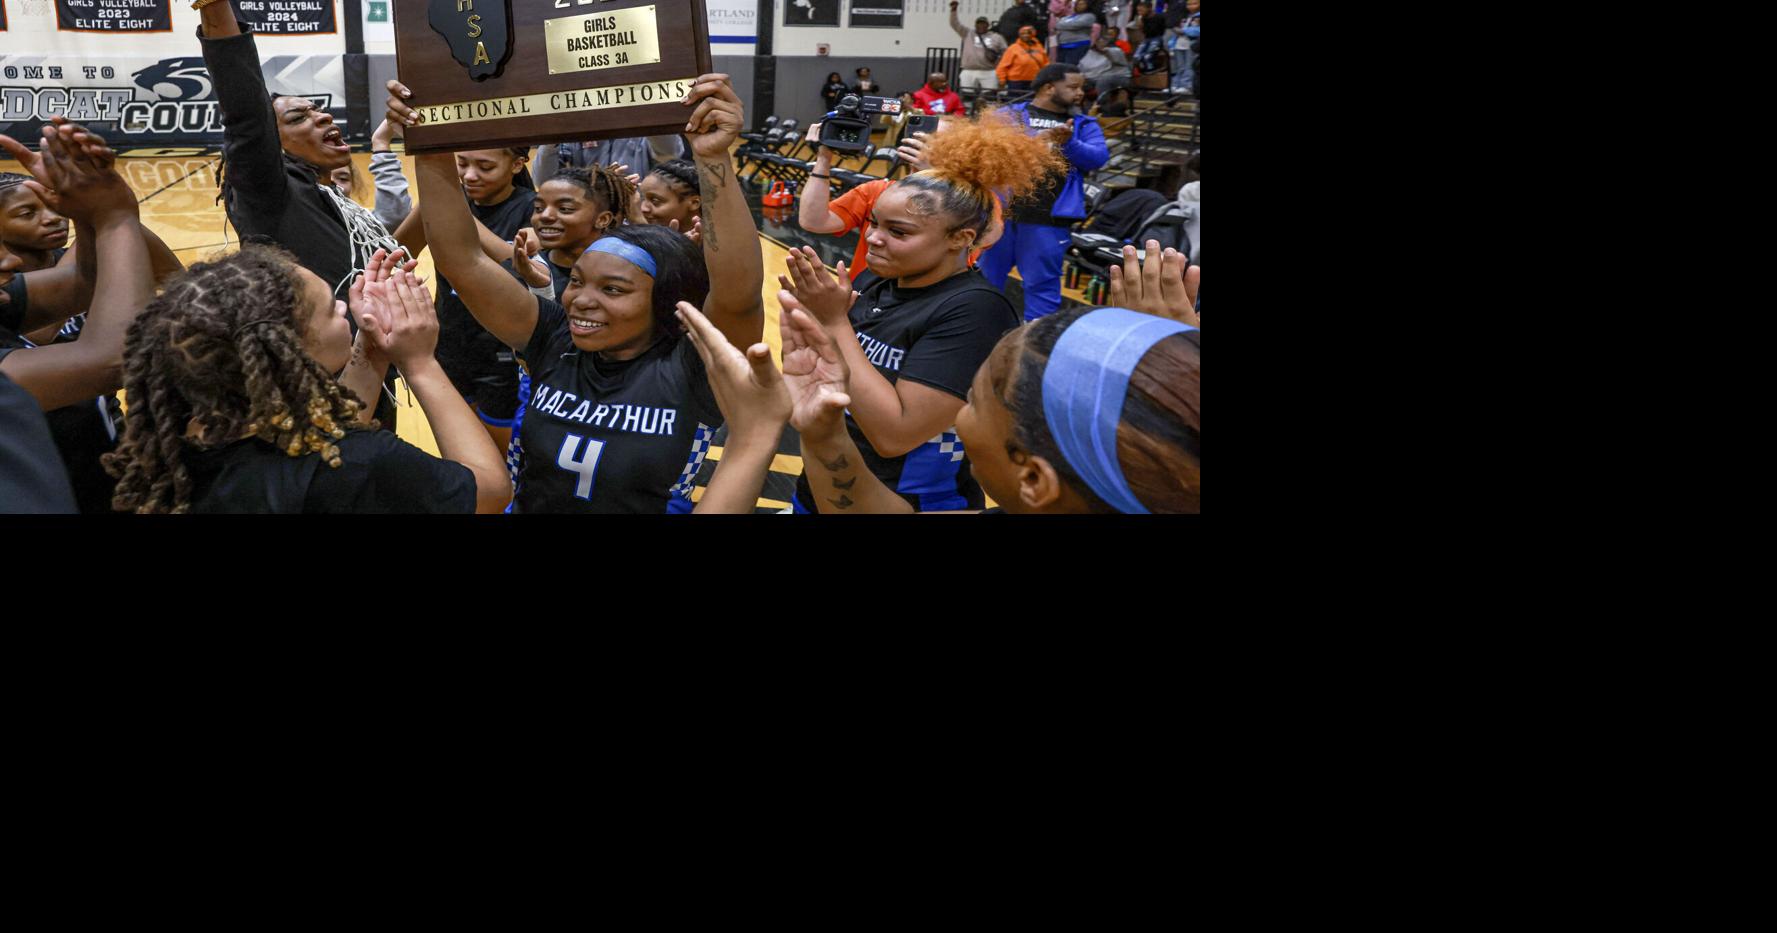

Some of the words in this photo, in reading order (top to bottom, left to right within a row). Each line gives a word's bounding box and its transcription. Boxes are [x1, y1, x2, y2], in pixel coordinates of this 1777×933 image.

[100, 0, 157, 8] VOLLEYBALL
[240, 1, 264, 11] GIRLS
[269, 1, 322, 11] VOLLEYBALL
[98, 9, 130, 18] 2023
[267, 12, 299, 21] 2024
[75, 19, 111, 28] ELITE
[119, 19, 154, 28] EIGHT
[287, 22, 320, 31] EIGHT
[584, 16, 616, 33] GIRLS
[567, 31, 637, 52] BASKETBALL
[578, 54, 610, 68] CLASS
[615, 52, 629, 64] 3A
[83, 66, 115, 79] TO
[419, 98, 530, 123] SECTIONAL
[551, 81, 685, 110] CHAMPIONS
[531, 383, 677, 435] MACARTHUR
[555, 431, 607, 501] 4
